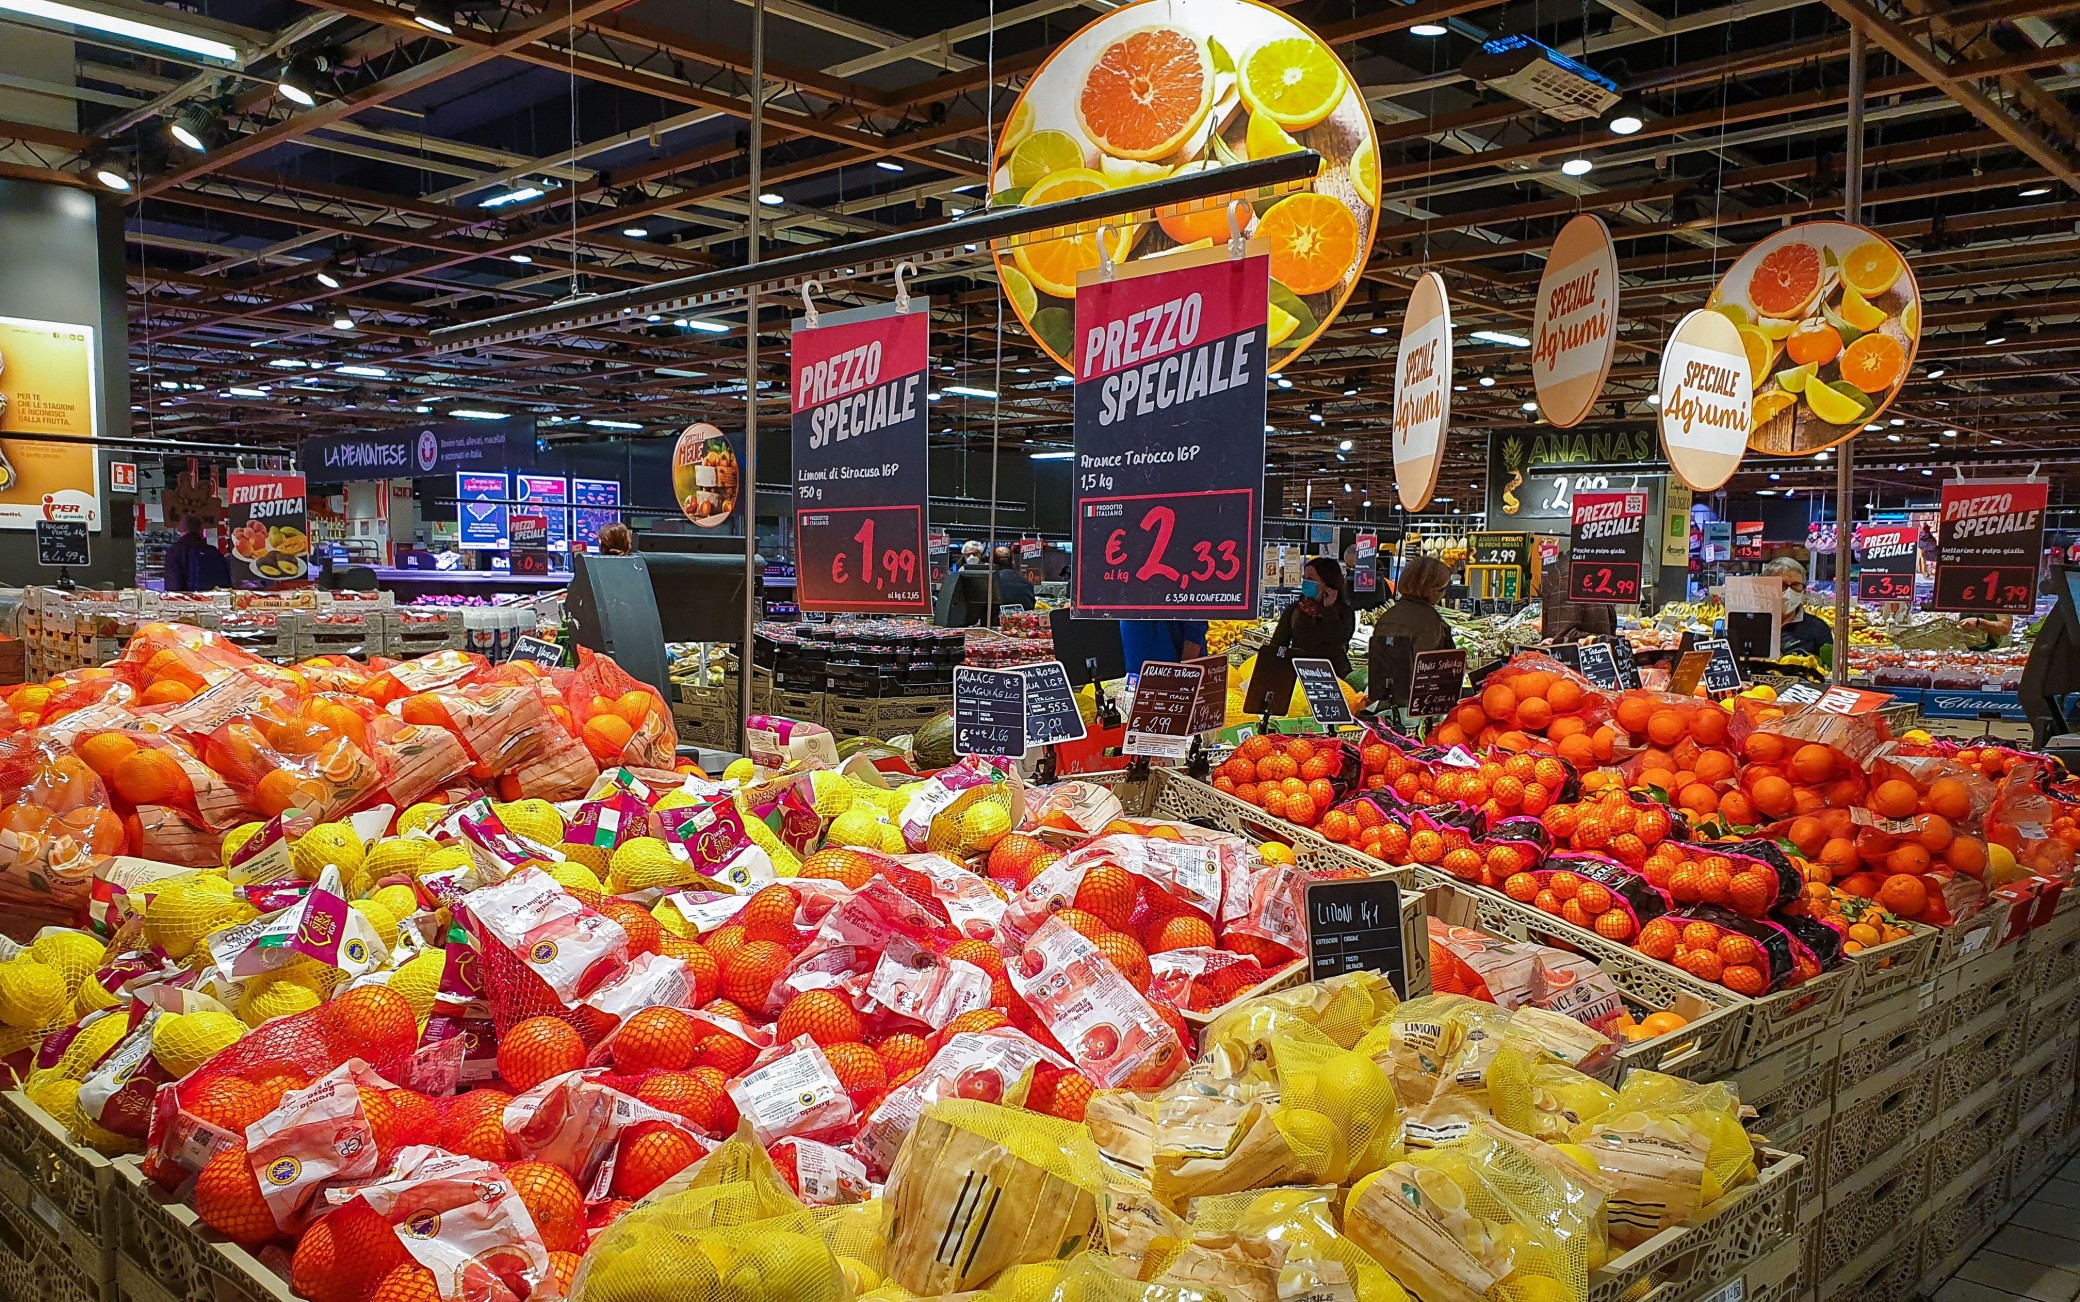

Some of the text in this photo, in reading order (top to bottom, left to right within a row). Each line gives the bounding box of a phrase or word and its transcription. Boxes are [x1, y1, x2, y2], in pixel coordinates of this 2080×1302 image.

[1548, 268, 1600, 320] SPECIALE
[1083, 293, 1202, 378] PREZZO
[1533, 298, 1609, 372] Agrumi
[1404, 338, 1437, 388] SPECIALE
[798, 340, 882, 408] PREZZO
[1099, 331, 1256, 426] SPECIALE
[1683, 360, 1740, 398] SPECIALE
[28, 409, 65, 417] RICONOSCI
[43, 403, 74, 411] STAGIONI
[810, 374, 920, 449] SPECIALE
[1394, 374, 1442, 446] Agrumi
[1664, 384, 1750, 434] Agrumi
[324, 443, 407, 467] LA PIEMONTESE
[1080, 445, 1200, 468] Arance Tarocco IGP
[1528, 431, 1649, 464] ANANAS
[798, 463, 899, 482] Limoni di Siracusa IGP
[1080, 473, 1113, 491] 1,5 kg
[232, 483, 283, 503] FRUTTA
[799, 486, 822, 500] 750 g
[249, 497, 303, 518] ESOTICA
[1575, 501, 1622, 524] PREZZO
[1945, 493, 2012, 521] PREZZO
[511, 519, 535, 532] PREZZO
[514, 528, 545, 540] SPECIALE
[1581, 515, 1642, 540] SPECIALE
[1953, 510, 2039, 539] SPECIALE
[1105, 505, 1240, 590] € 2,33
[1863, 533, 1900, 549] PREZZO
[1867, 542, 1915, 560] SPECIALE
[832, 518, 916, 590] € 1,99
[1490, 550, 1516, 564] 2,99
[1104, 569, 1129, 583] al kg
[1583, 567, 1634, 595] € 2,99
[1879, 577, 1911, 596] 3,50
[1165, 594, 1170, 602] €
[1172, 593, 1188, 603] 3,50
[1195, 593, 1242, 602] CONFEZIONE
[957, 669, 996, 684] ARANCE
[1143, 666, 1172, 677] ARANCE
[960, 729, 968, 741] €
[1404, 1023, 1441, 1038] LIMONI
[300, 1091, 335, 1109] Arancia
[341, 1135, 363, 1156] IGP
